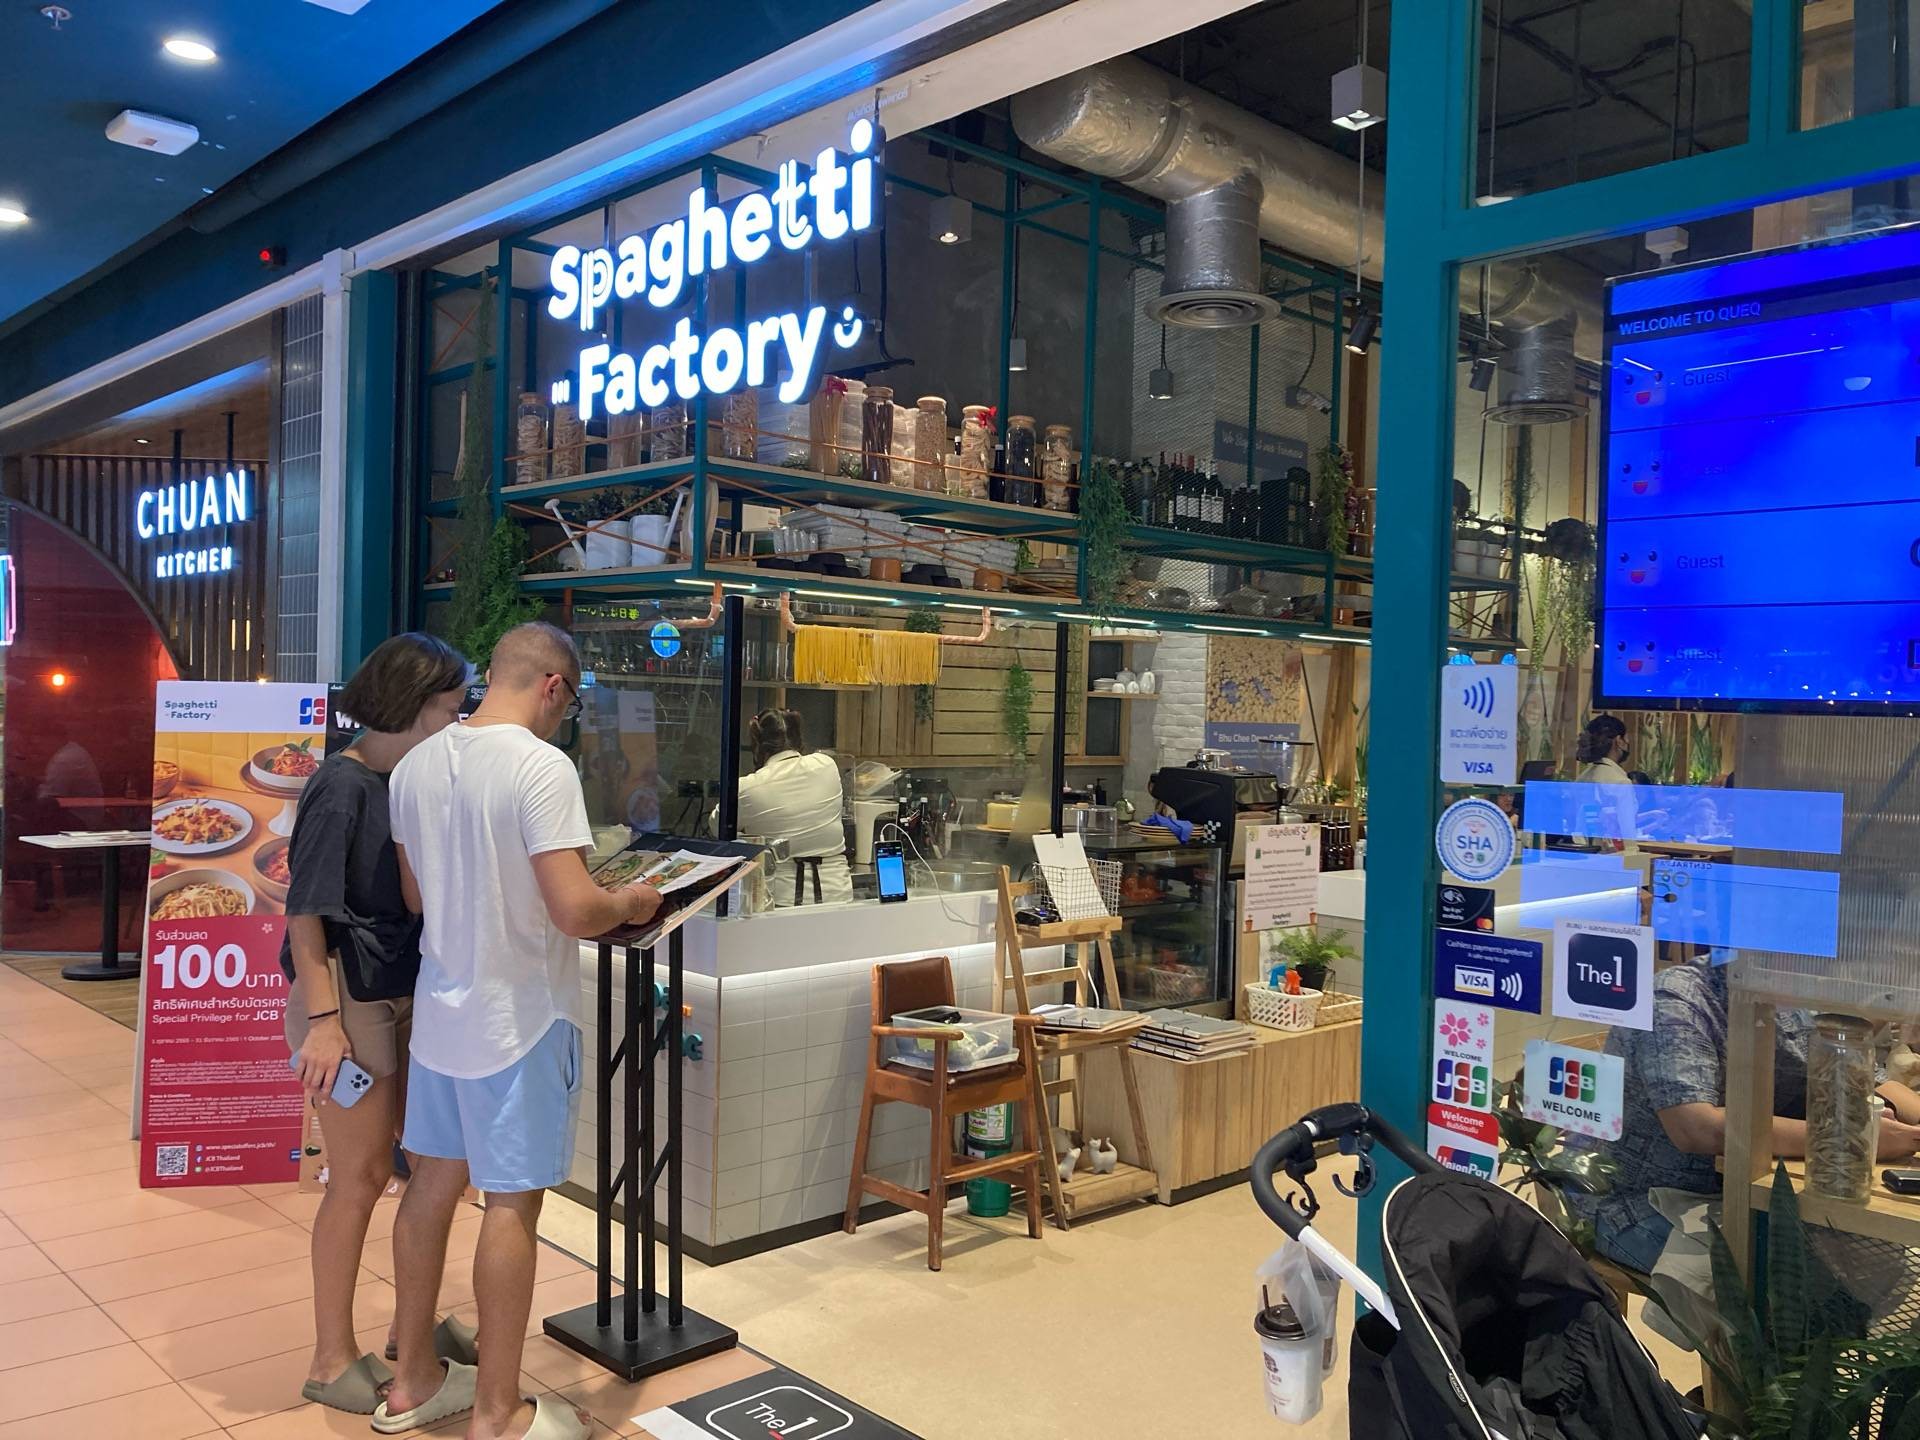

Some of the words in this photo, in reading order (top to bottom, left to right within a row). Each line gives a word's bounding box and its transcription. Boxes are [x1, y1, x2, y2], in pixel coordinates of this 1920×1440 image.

[548, 118, 873, 331] Spaghetti
[1619, 313, 1692, 335] WELCOME
[1694, 309, 1715, 324] TO
[1718, 302, 1761, 320] QUEQ
[579, 305, 827, 420] Factory
[1683, 369, 1731, 387] Guest
[138, 469, 246, 539] CHUAN
[157, 546, 231, 577] KITCHEN
[1676, 554, 1725, 569] Guest
[1674, 647, 1722, 662] Guest
[165, 700, 218, 710] Spaghetti
[171, 711, 211, 720] Factory
[1463, 761, 1494, 774] VISA
[1456, 835, 1493, 851] SHA
[155, 929, 208, 941] รับส่วนลด
[153, 943, 247, 989] 100
[245, 973, 282, 988] บาท
[1461, 973, 1490, 988] VISA
[152, 997, 286, 1011] สิทธิพิเศษสำหรับบัตรเคร
[152, 1014, 188, 1024] Special
[191, 1013, 232, 1024] Privilege
[235, 1012, 250, 1021] for
[253, 1010, 279, 1021] JCB
[1443, 1050, 1482, 1062] WELCOME
[1542, 1099, 1602, 1122] WELCOME
[1441, 1110, 1484, 1128] Welcome
[1437, 1156, 1490, 1180] UnionPay
